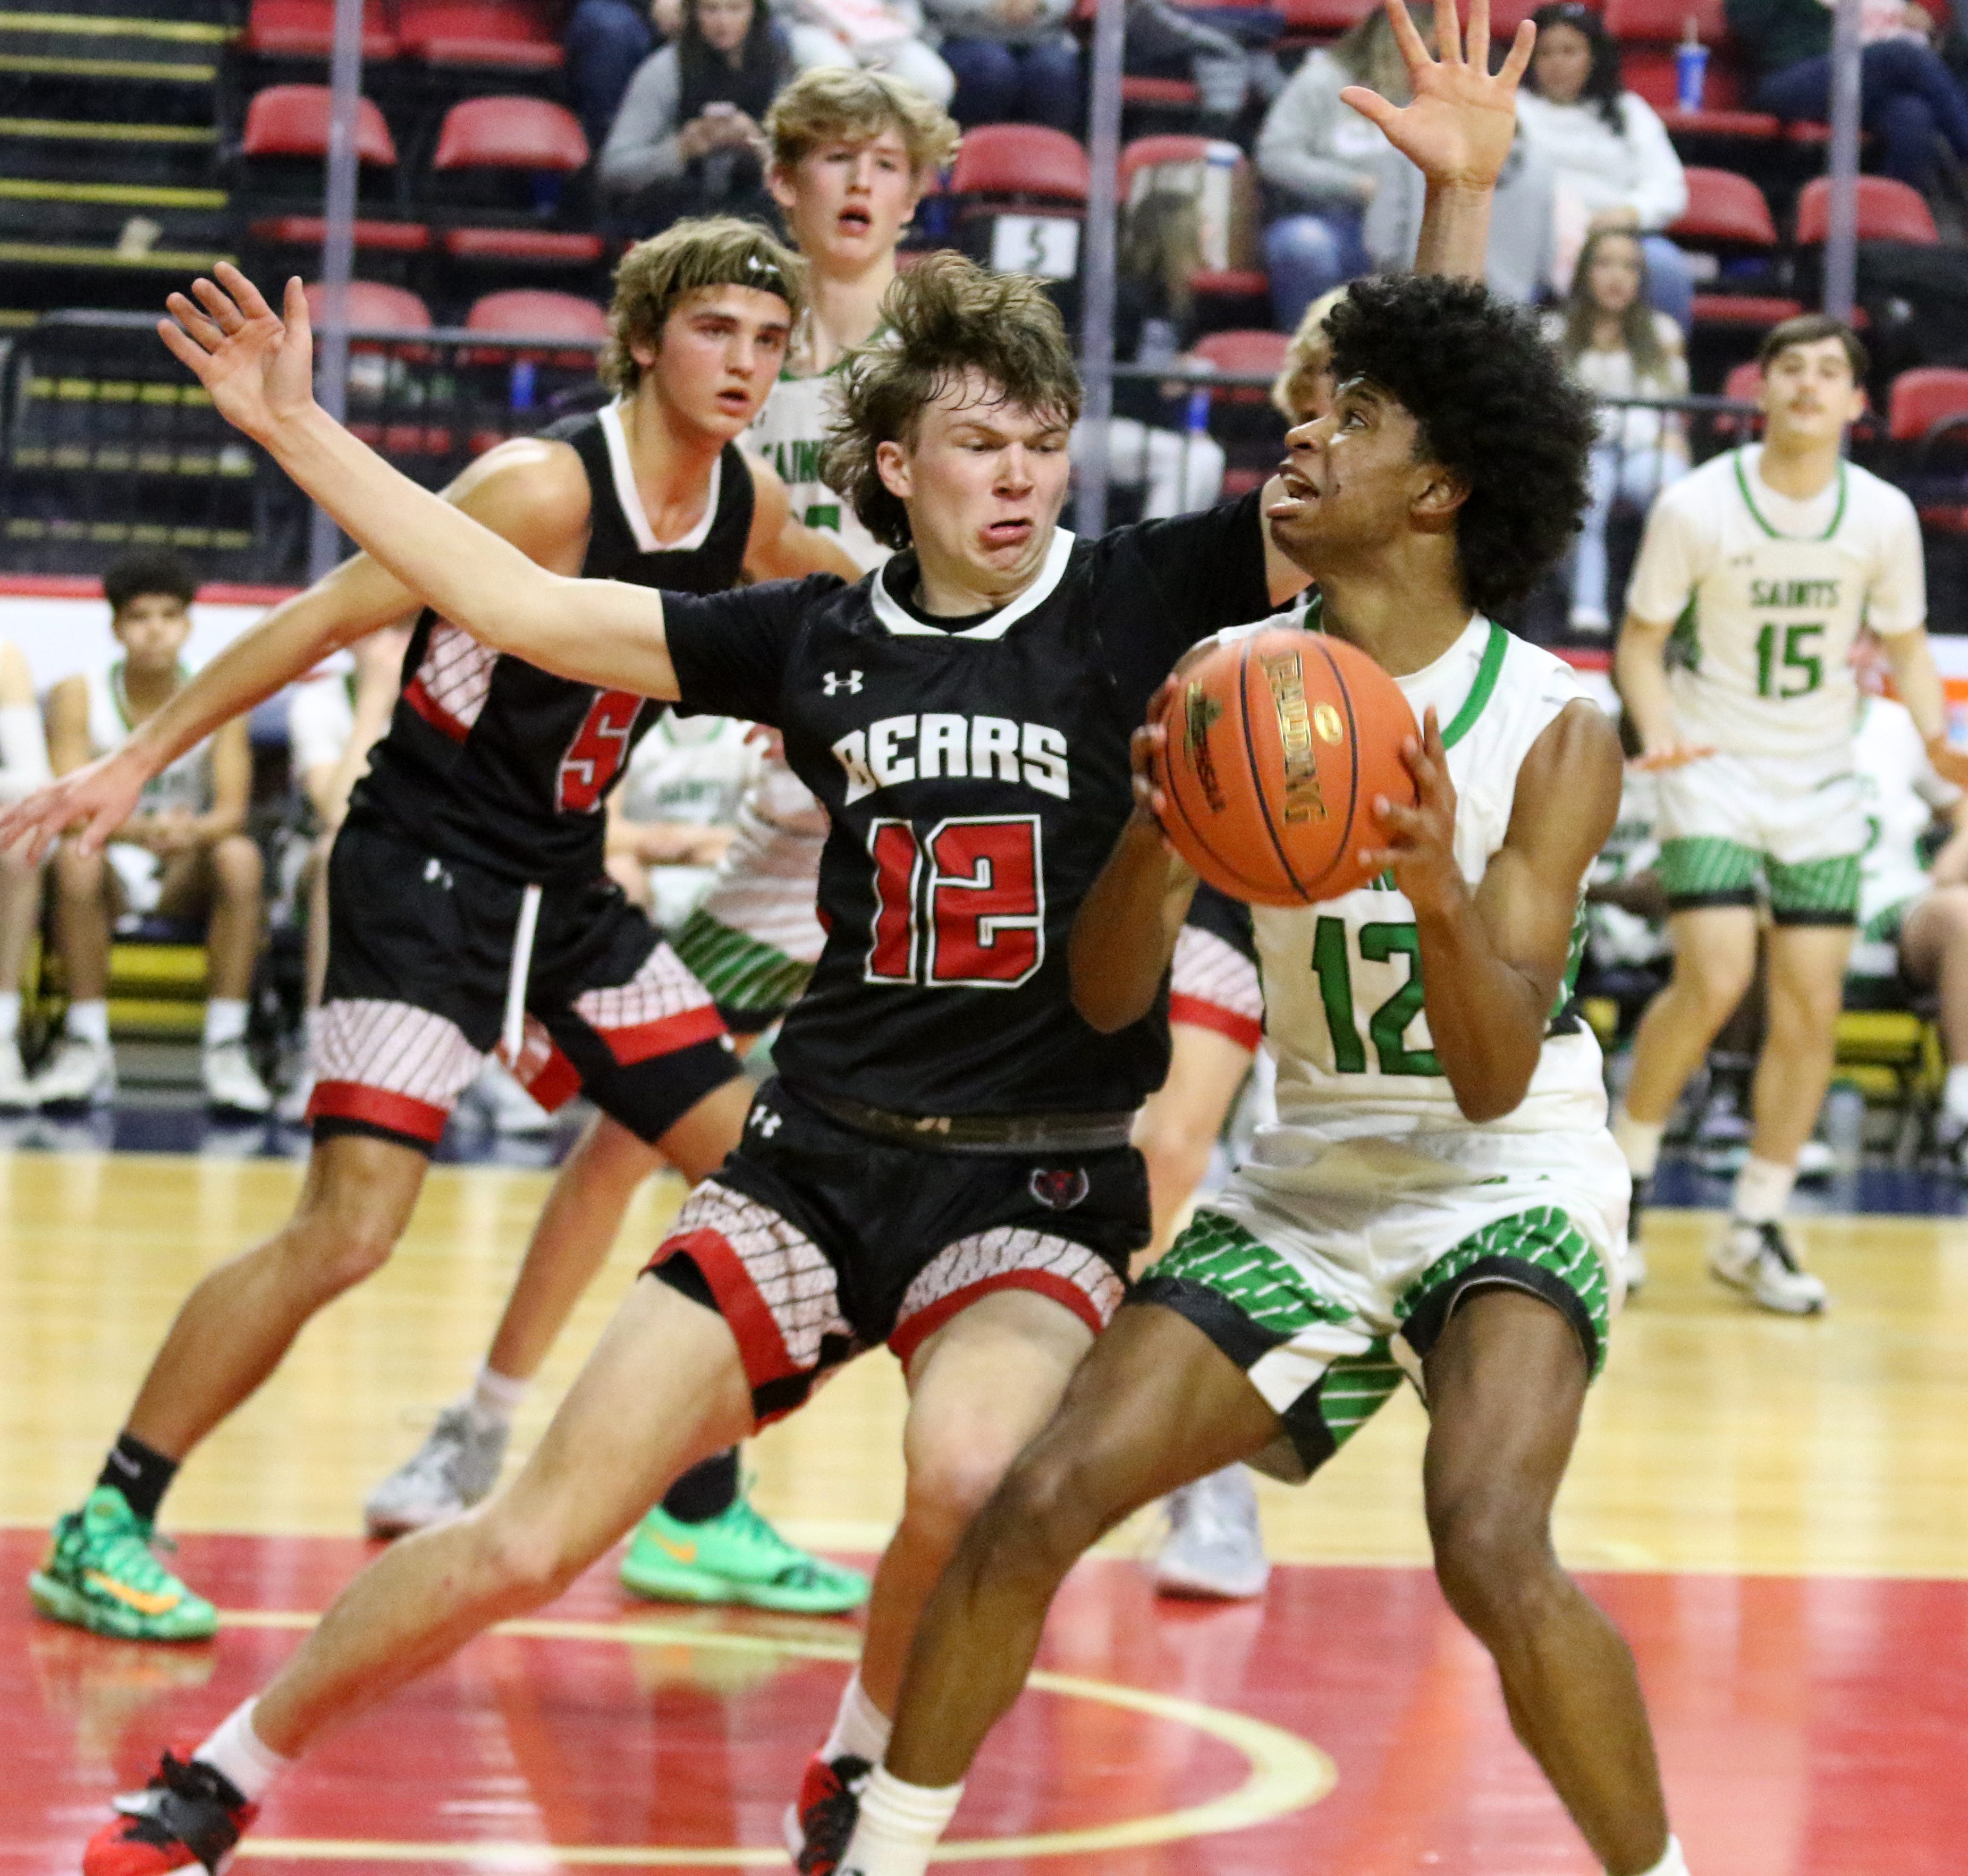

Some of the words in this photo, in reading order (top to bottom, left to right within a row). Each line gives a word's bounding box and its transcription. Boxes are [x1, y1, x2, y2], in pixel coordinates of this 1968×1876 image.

[1751, 579, 1841, 607] SAINTS
[1755, 622, 1825, 699] 15
[554, 689, 647, 813] 5
[831, 713, 1070, 807] BEARS
[864, 814, 1046, 990] 12
[1312, 915, 1446, 1077] 12
